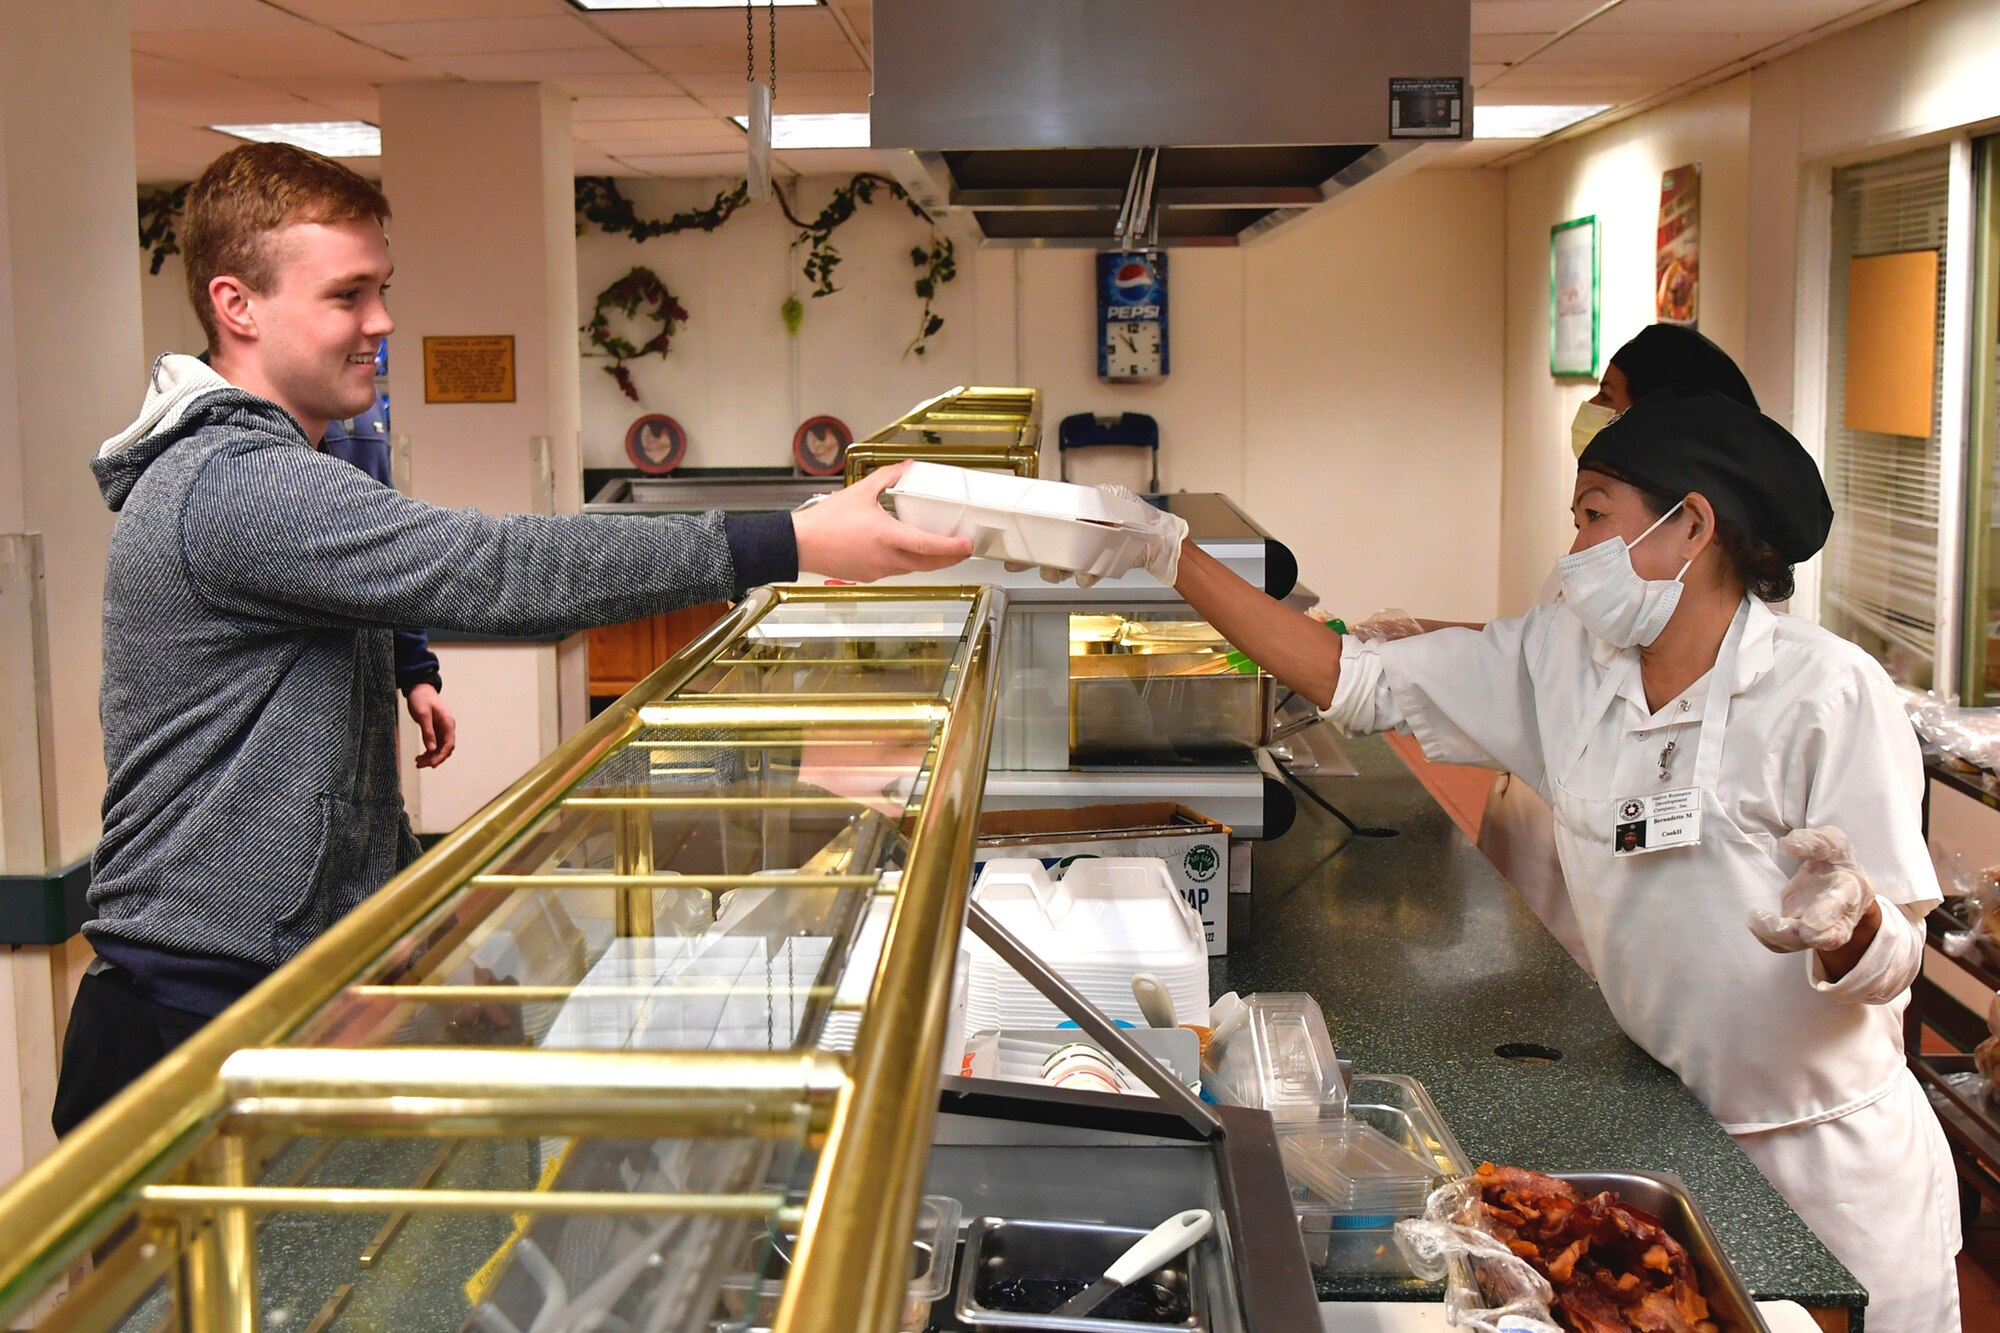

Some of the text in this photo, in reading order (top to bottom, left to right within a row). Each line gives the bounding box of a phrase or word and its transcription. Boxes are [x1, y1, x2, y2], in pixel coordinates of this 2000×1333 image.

[1107, 304, 1160, 319] PEPSI
[1127, 323, 1139, 333] 12
[1653, 815, 1684, 824] Bernadette
[1180, 888, 1209, 915] AP
